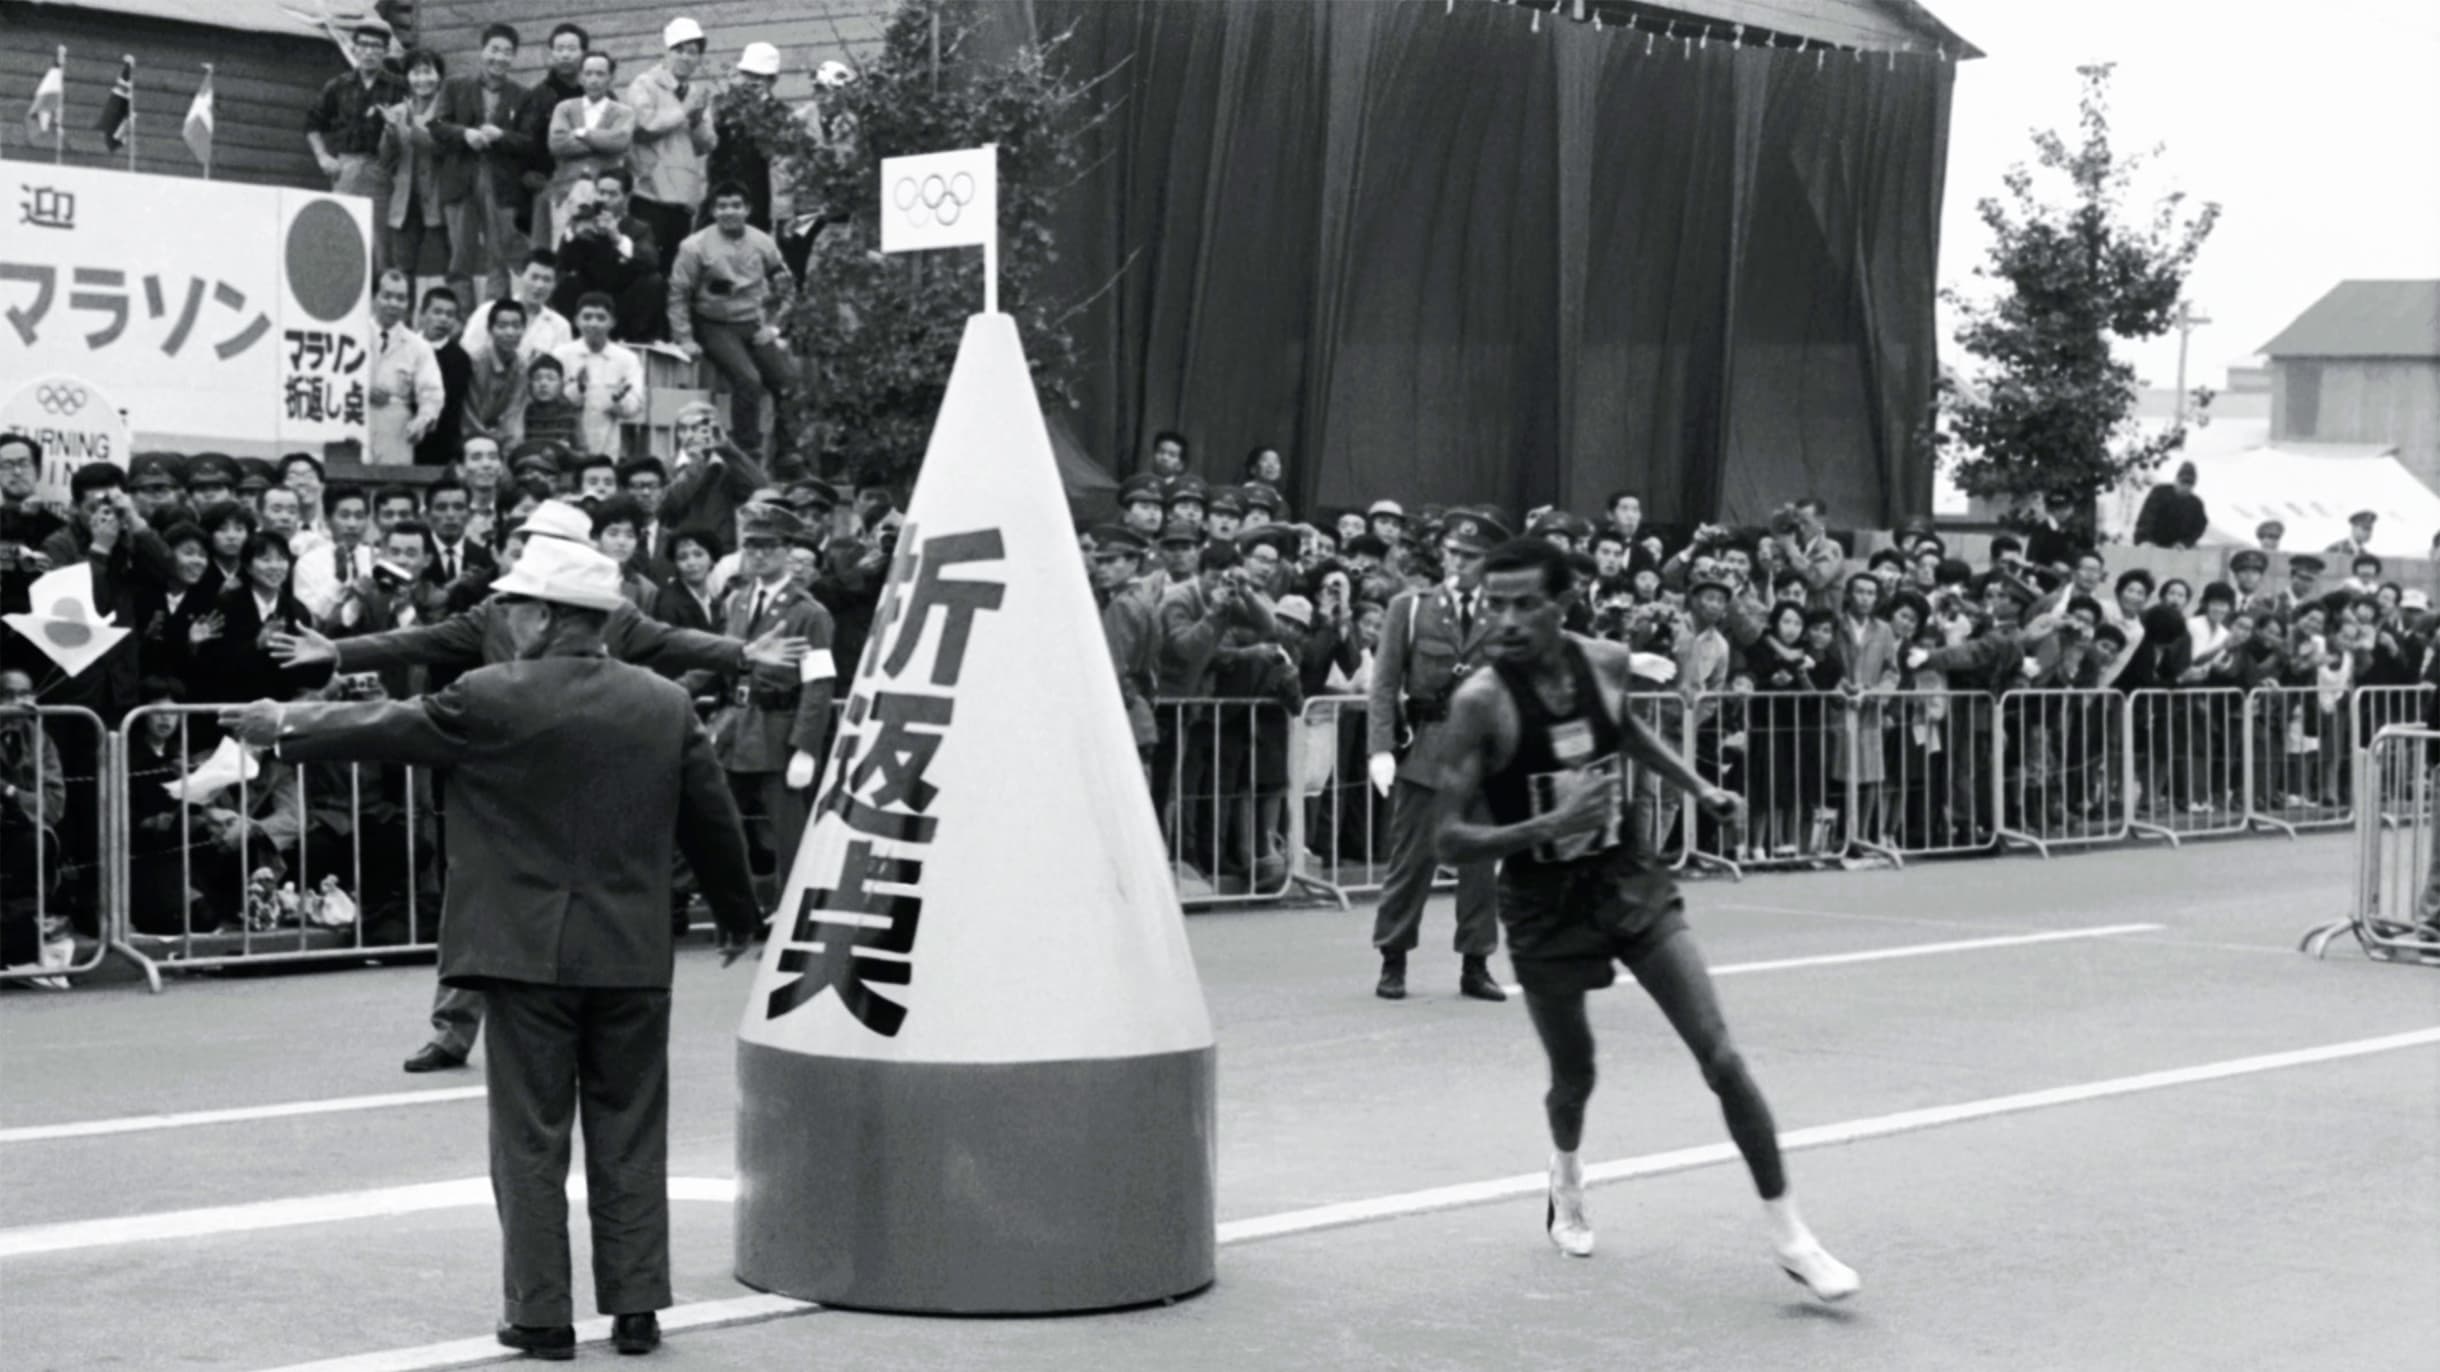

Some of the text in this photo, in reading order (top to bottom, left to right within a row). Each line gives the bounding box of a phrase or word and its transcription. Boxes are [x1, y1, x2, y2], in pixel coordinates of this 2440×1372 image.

[19, 184, 75, 230] 迎
[0, 262, 272, 361] マラソン
[284, 329, 366, 374] マラソン
